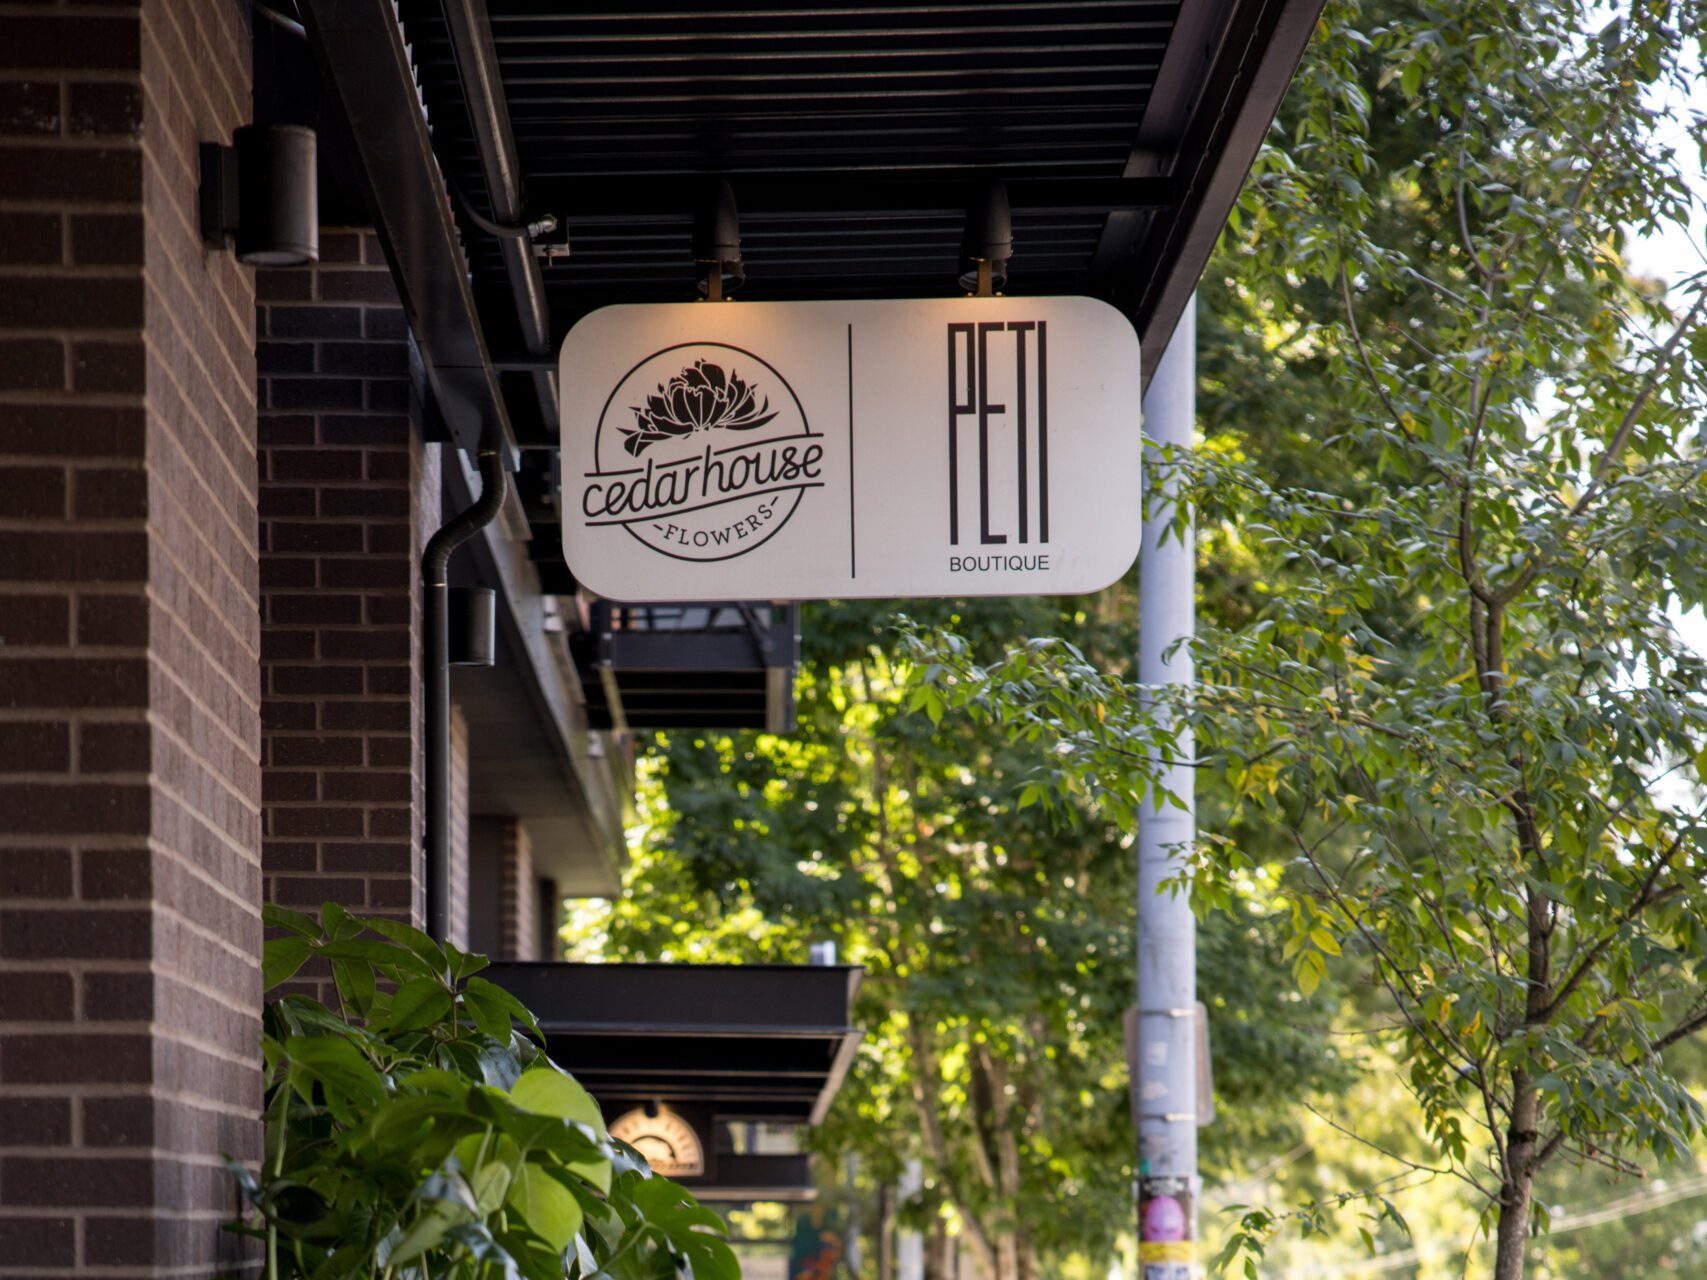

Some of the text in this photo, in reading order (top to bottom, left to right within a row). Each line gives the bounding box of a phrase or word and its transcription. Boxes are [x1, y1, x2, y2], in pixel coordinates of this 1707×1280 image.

[948, 321, 1049, 545] PETI
[583, 445, 823, 517] cedarhouse
[950, 555, 1050, 572] BOUTIQUE
